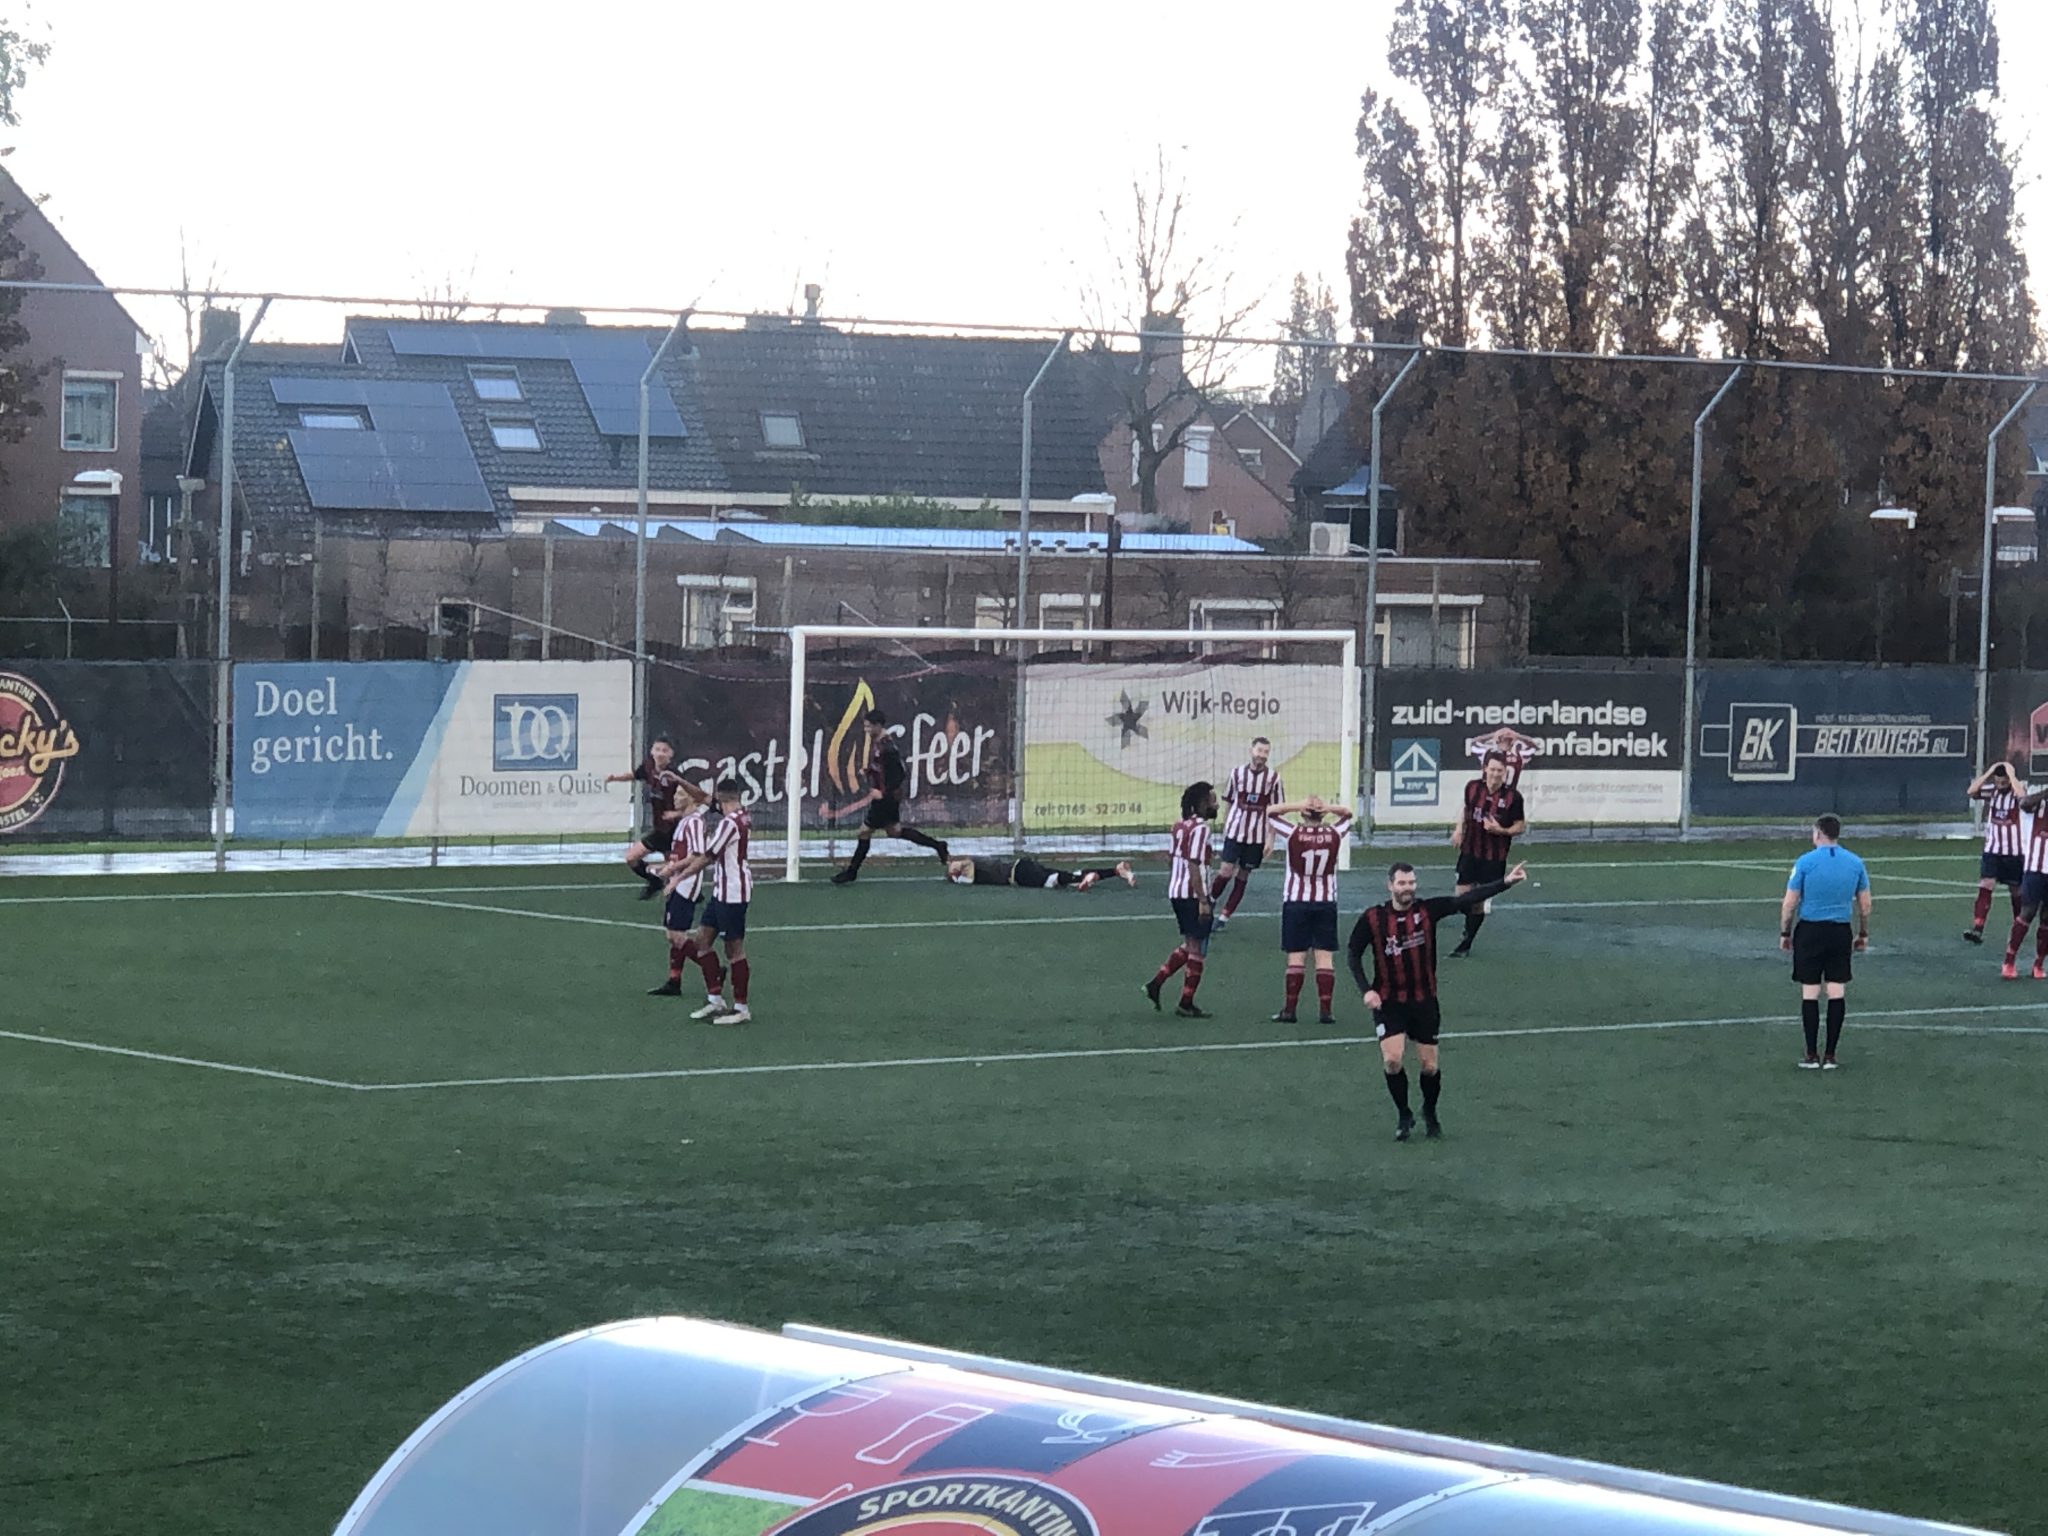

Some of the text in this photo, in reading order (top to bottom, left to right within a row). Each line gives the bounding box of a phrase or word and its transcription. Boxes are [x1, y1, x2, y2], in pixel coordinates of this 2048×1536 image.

[254, 677, 337, 717] Doel
[1162, 690, 1280, 720] Wijk-Regio
[251, 724, 394, 774] gericht.
[1465, 731, 1668, 757] renfabriek
[1739, 718, 1784, 761] BK
[1814, 728, 1850, 754] BEN
[1852, 728, 1930, 754] KOUTERS
[460, 775, 541, 796] Doomen
[558, 773, 609, 795] Quist
[1301, 849, 1330, 876] 17
